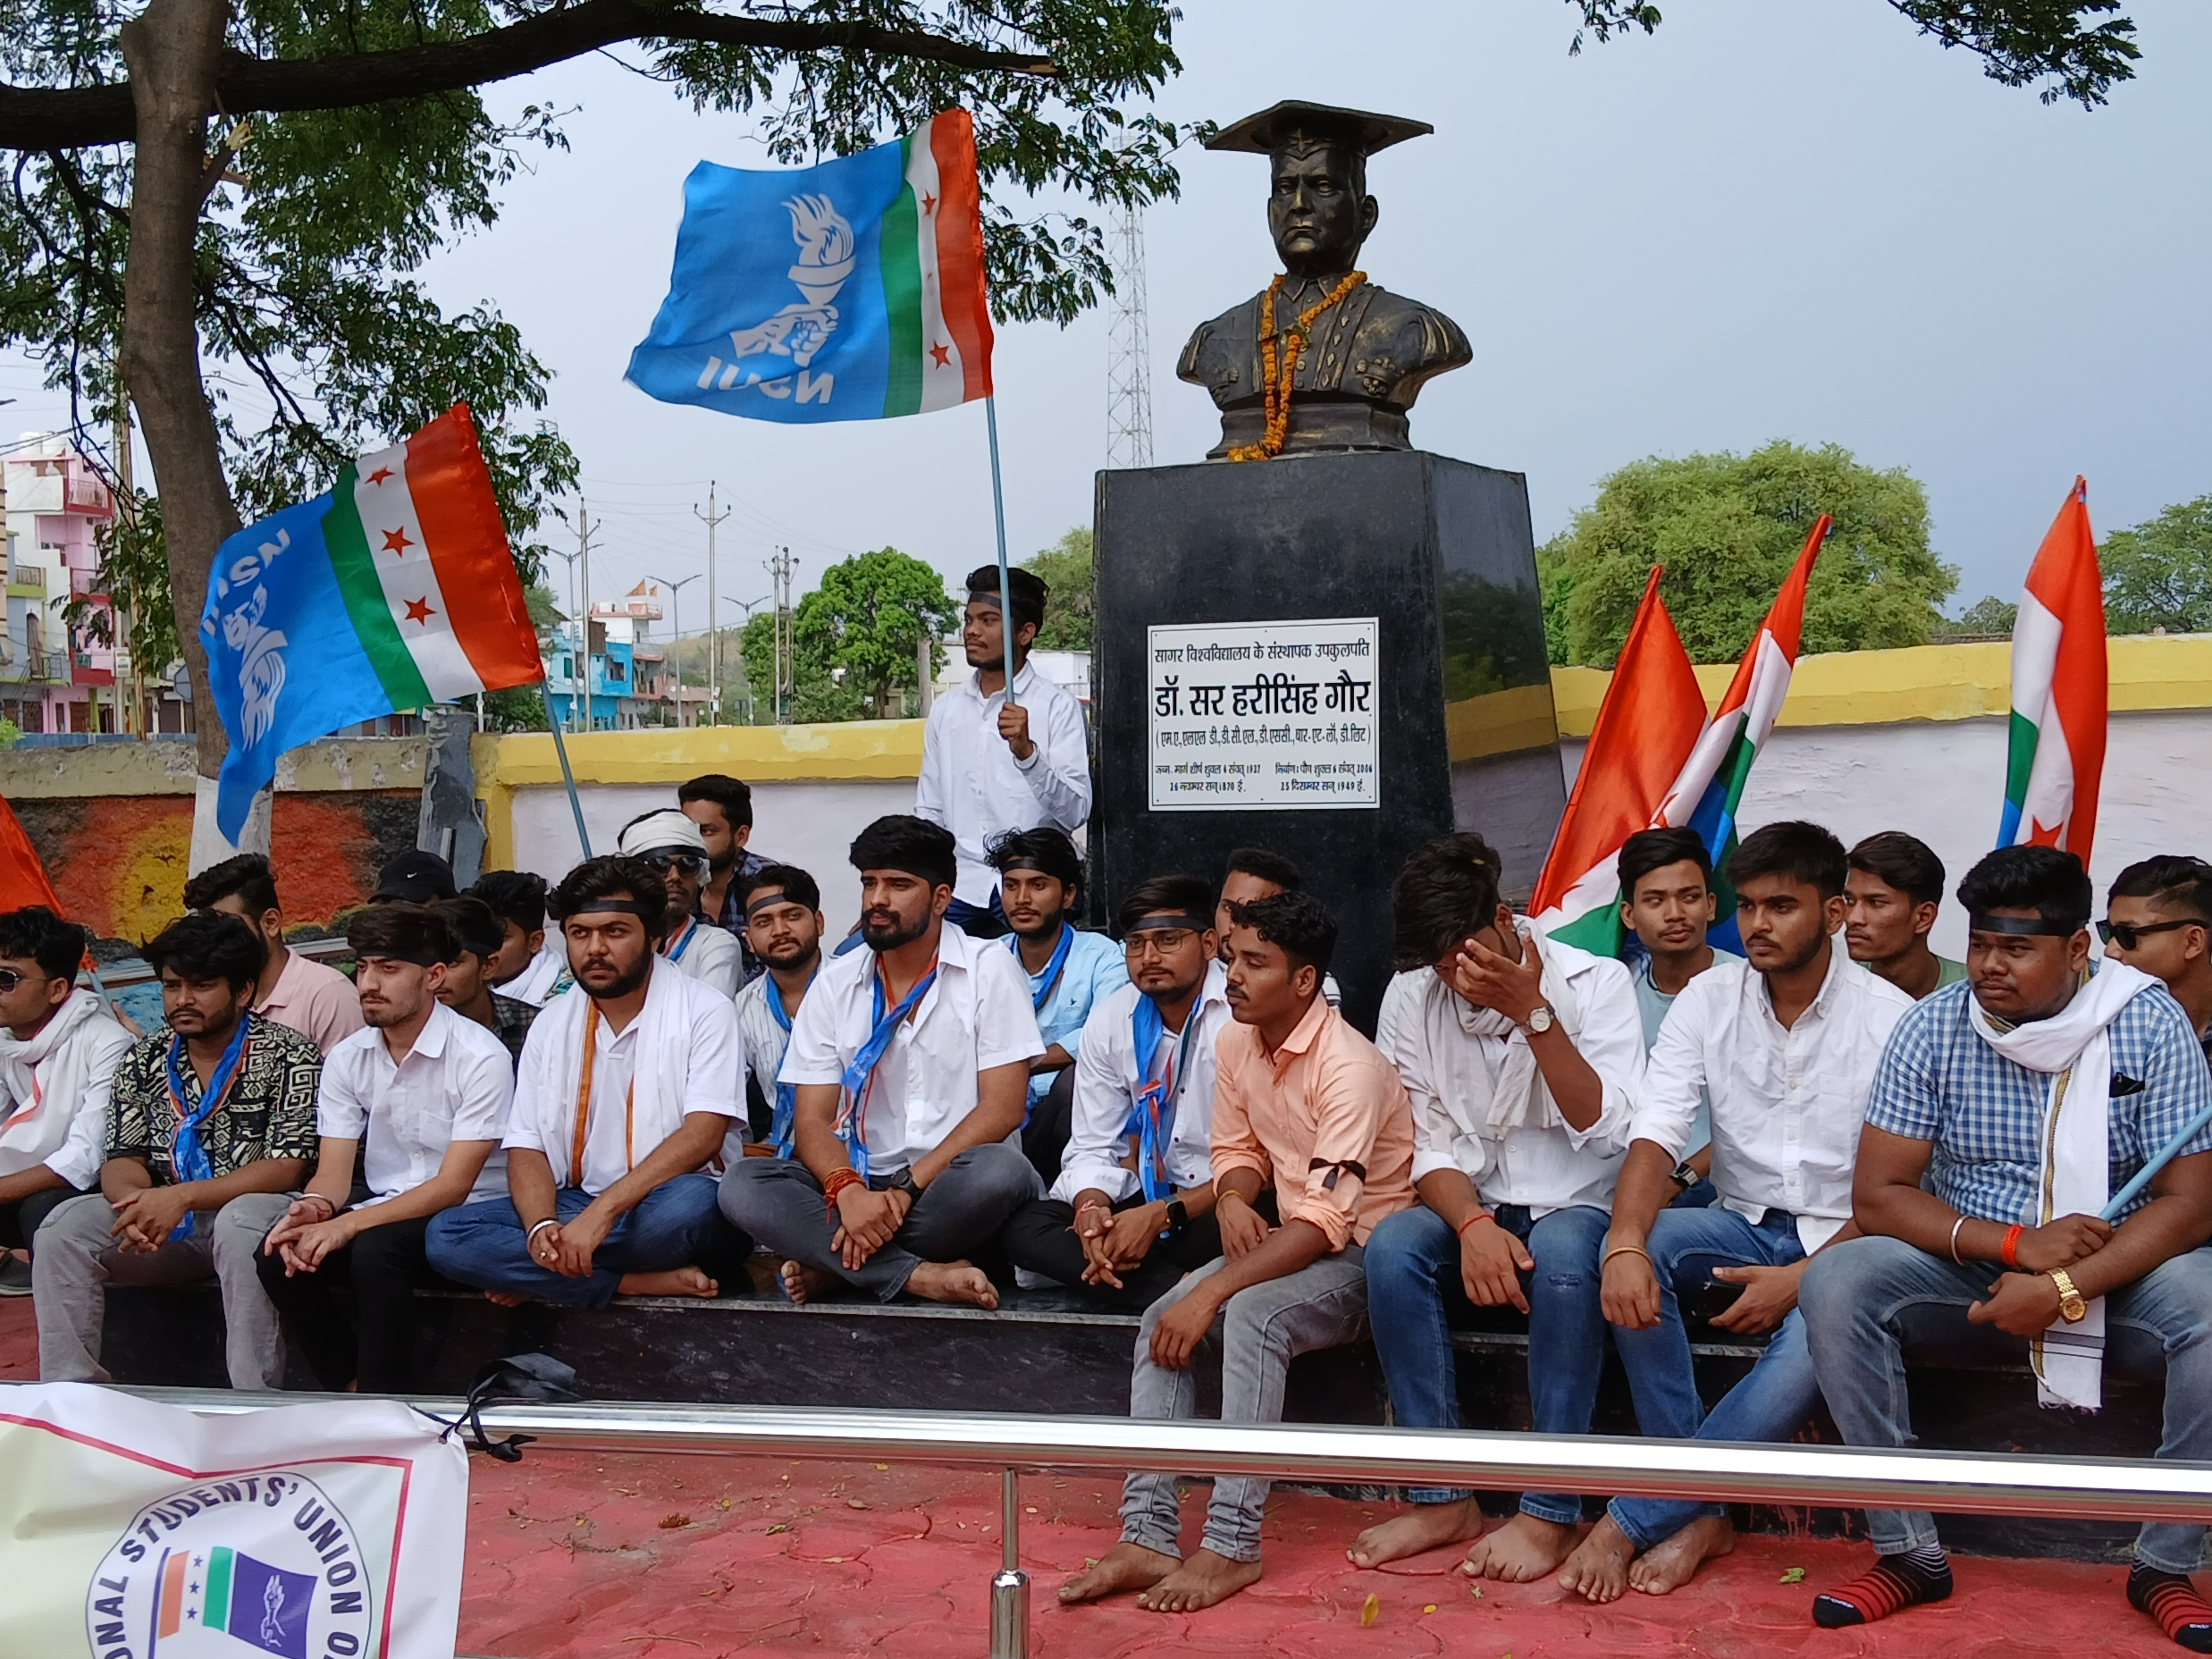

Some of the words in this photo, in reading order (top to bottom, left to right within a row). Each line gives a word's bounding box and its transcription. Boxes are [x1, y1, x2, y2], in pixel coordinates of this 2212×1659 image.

[1155, 648, 1183, 664] सागर
[1187, 644, 1250, 662] विश्वविद्यालय
[1253, 641, 1265, 660] के
[1267, 641, 1312, 660] संस्थापक
[1315, 637, 1370, 661] उपकुलपति
[1155, 675, 1184, 717] डॉ.
[1189, 686, 1225, 716] सर
[1232, 672, 1320, 715] हरीसिंह
[1325, 669, 1371, 712] गौर
[294, 1496, 363, 1614] UNION
